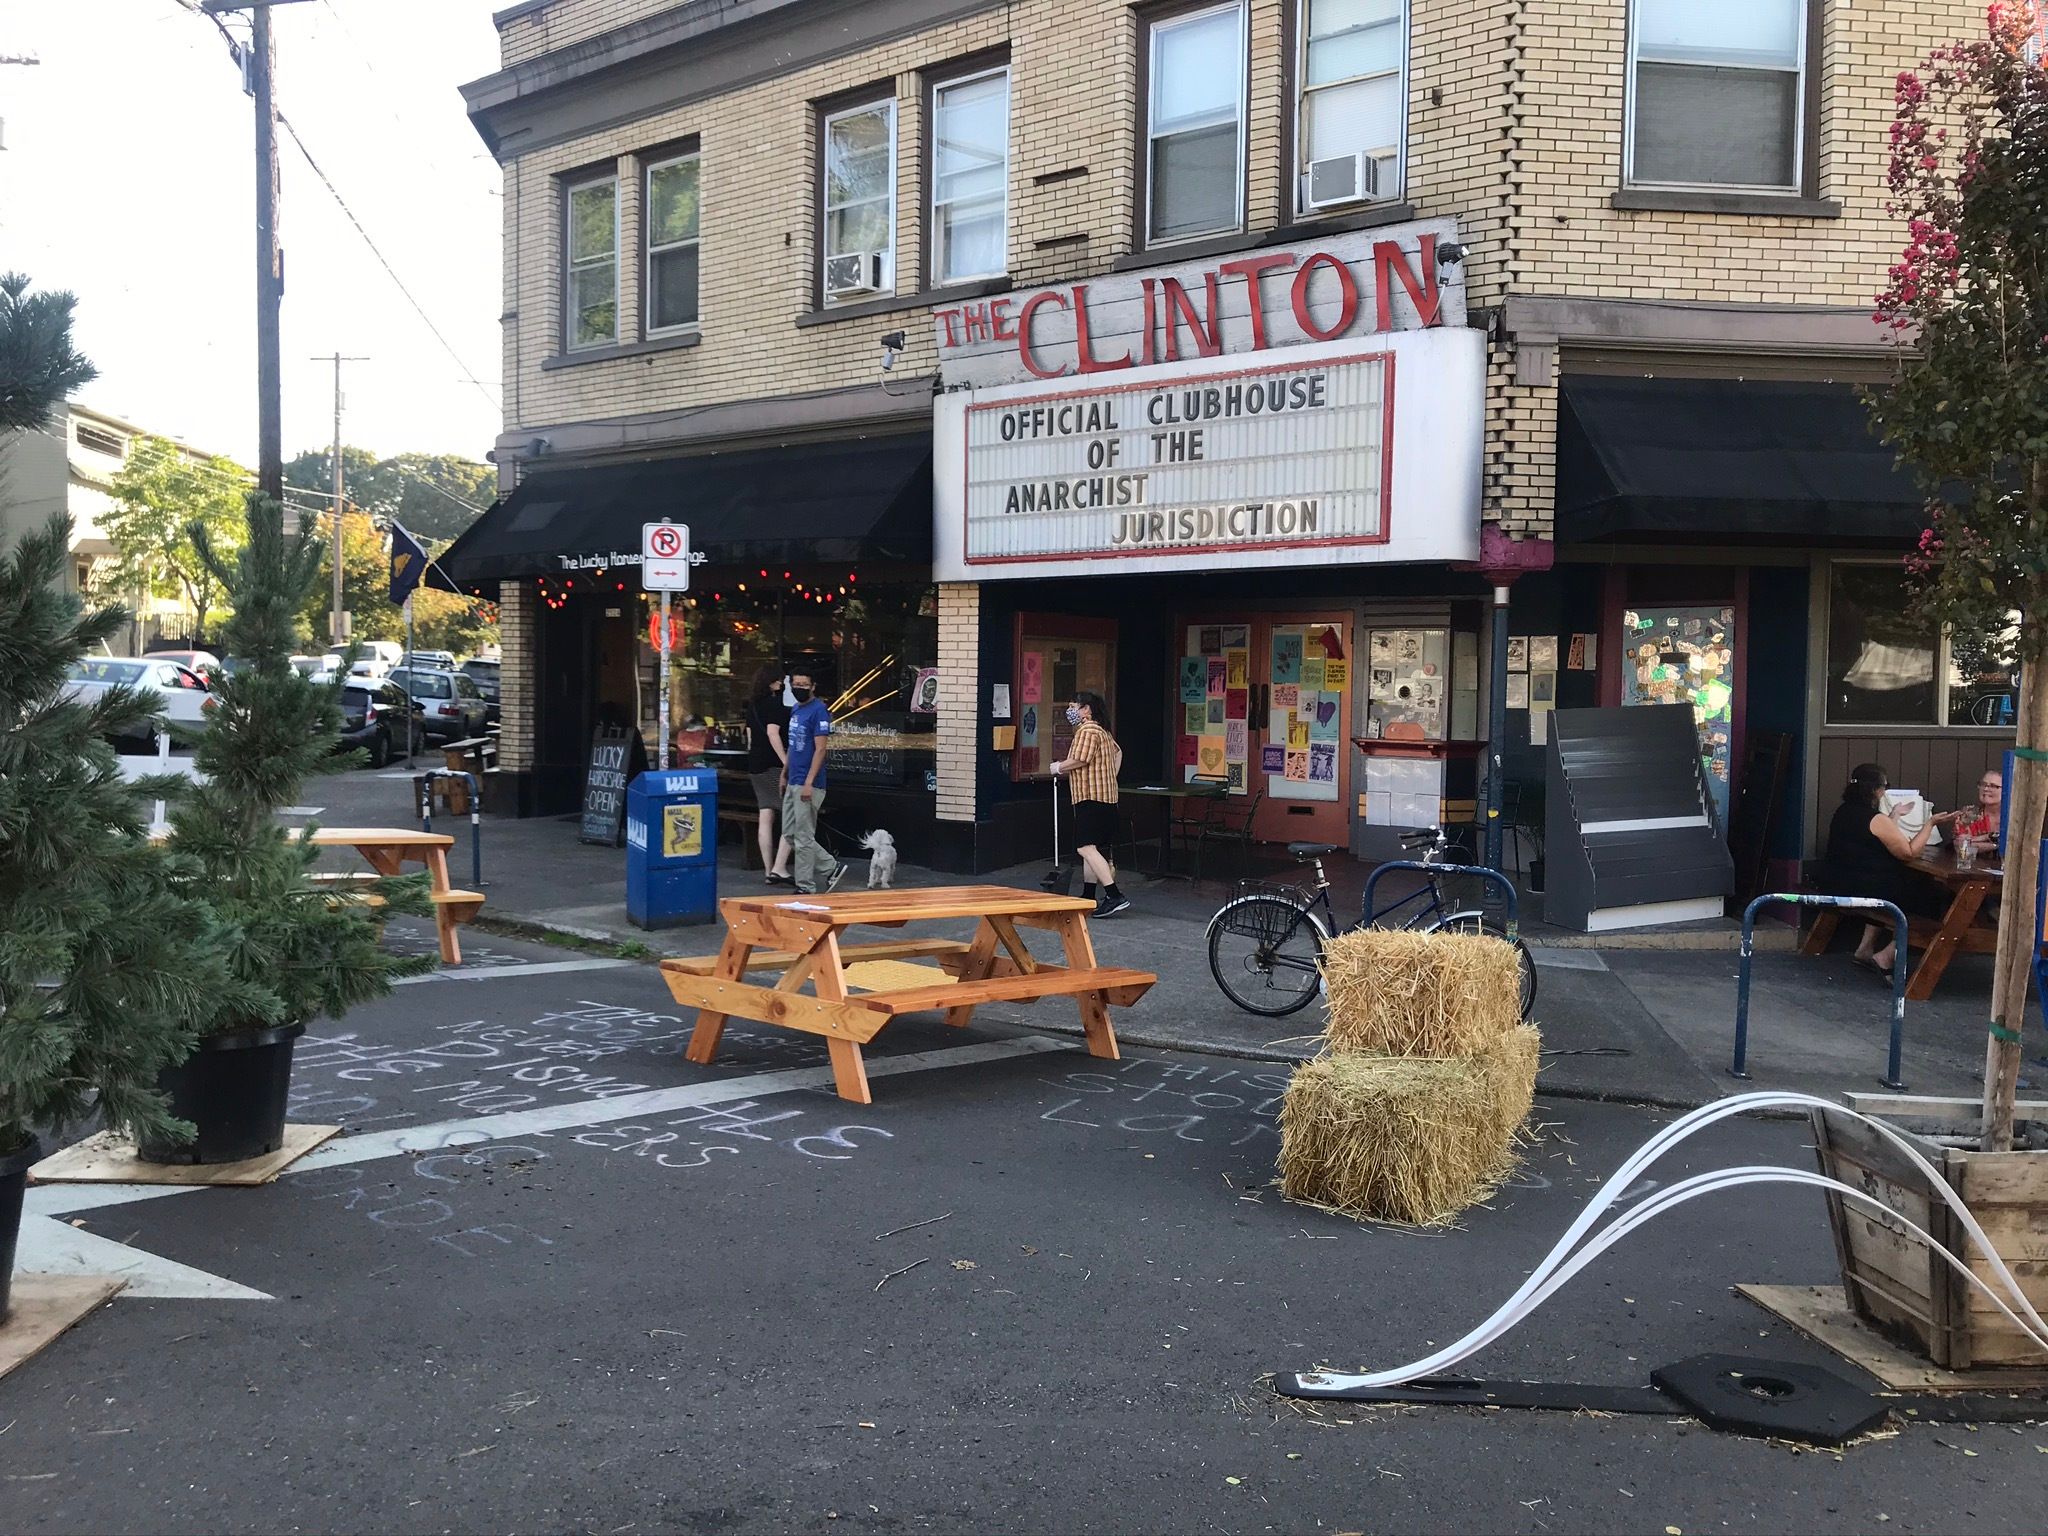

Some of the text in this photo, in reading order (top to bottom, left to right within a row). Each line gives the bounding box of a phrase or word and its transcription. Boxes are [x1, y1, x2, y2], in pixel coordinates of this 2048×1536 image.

[934, 232, 1442, 379] THE CLINTON
[1000, 374, 1326, 442] OFFICIAL CLUBHOUSE
[1087, 429, 1204, 470] OF THE
[1005, 473, 1149, 514] ANARCHIST
[1111, 500, 1319, 545] JURISDICTION
[557, 555, 578, 570] The
[579, 553, 608, 570] Lucky
[593, 746, 624, 769] LUCKY
